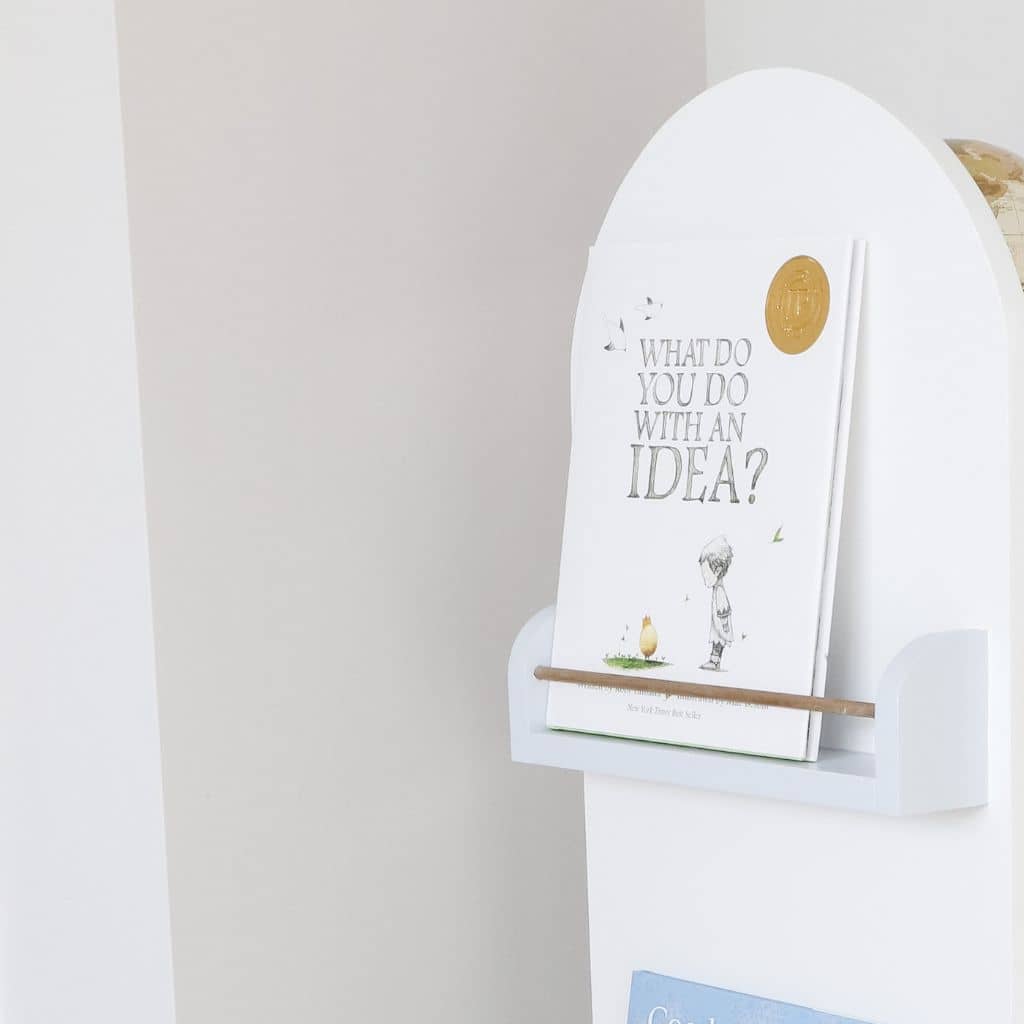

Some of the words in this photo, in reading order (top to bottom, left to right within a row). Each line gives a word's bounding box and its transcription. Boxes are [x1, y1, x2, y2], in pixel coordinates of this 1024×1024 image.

[640, 338, 711, 367] WHAT
[714, 338, 752, 367] DO
[637, 372, 697, 407] YOU
[704, 372, 749, 407] DO
[634, 410, 703, 441] WITH
[708, 412, 746, 442] AN
[627, 444, 769, 504] IDEA?
